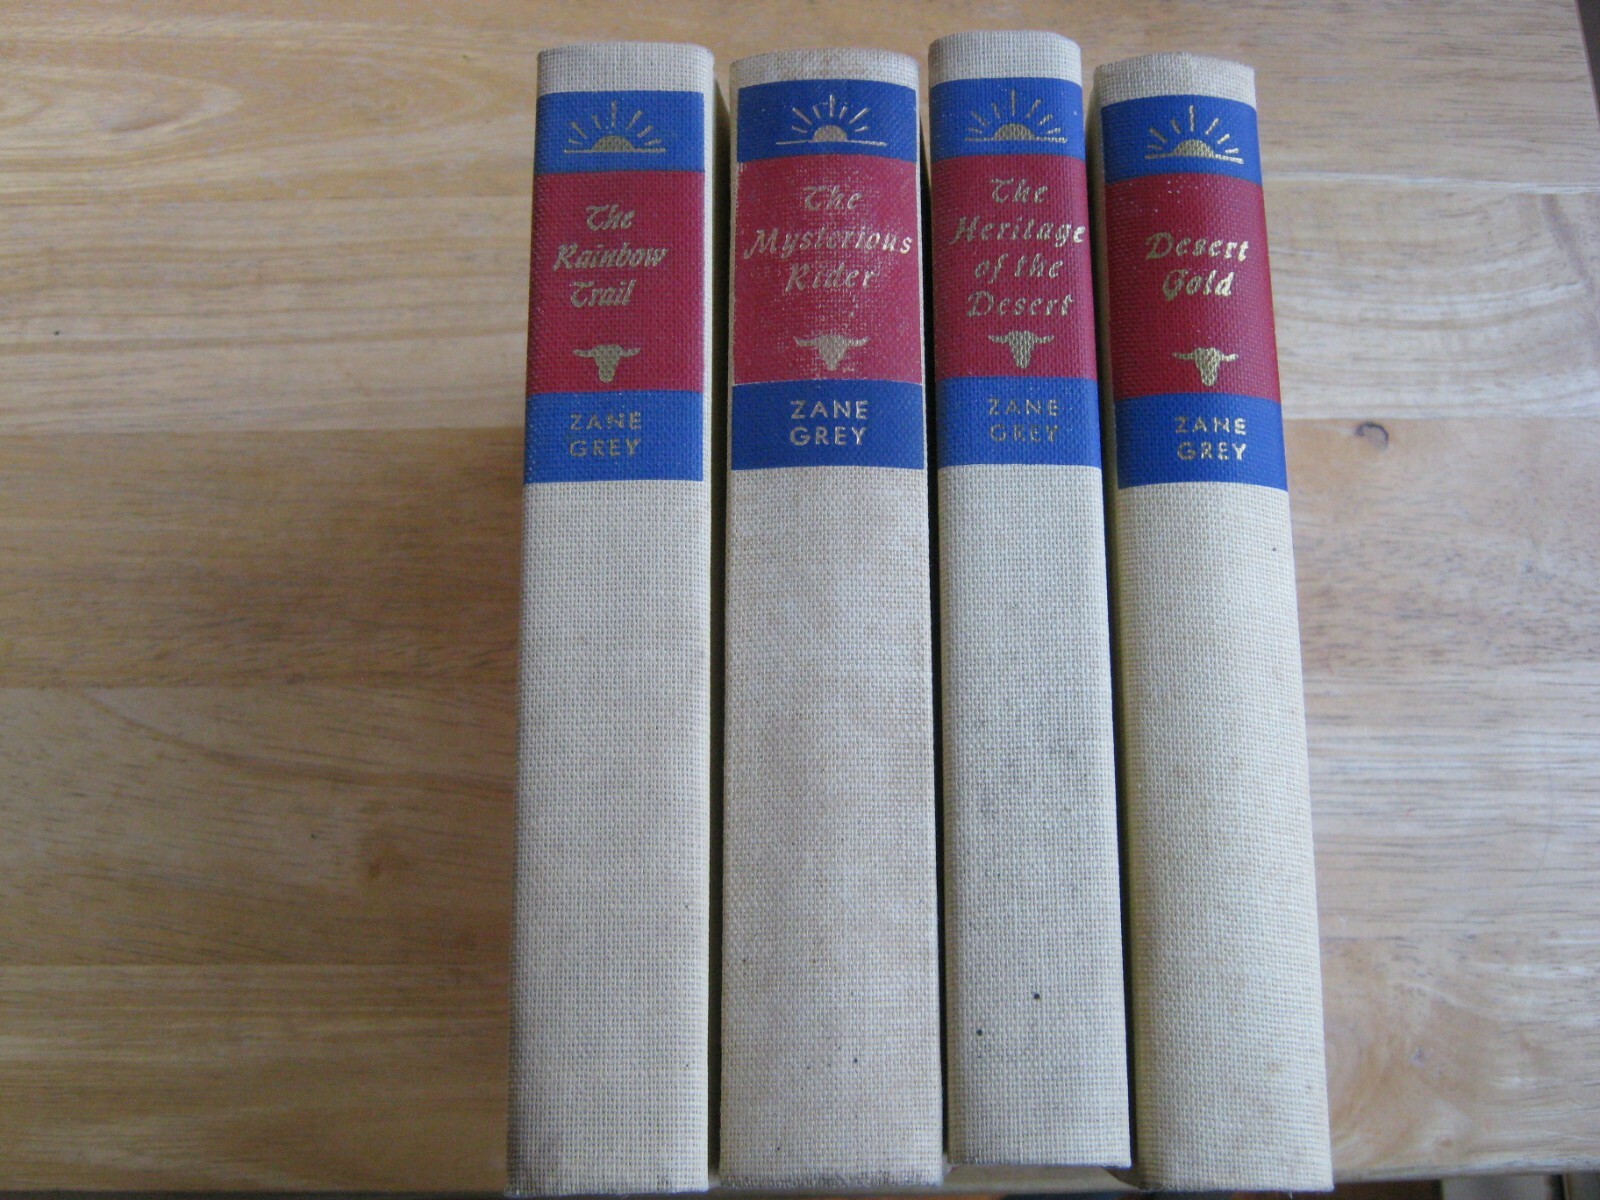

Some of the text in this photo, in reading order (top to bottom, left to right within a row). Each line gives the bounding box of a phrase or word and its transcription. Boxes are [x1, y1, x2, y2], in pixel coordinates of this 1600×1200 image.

[802, 185, 863, 211] The
[990, 177, 1049, 204] The
[585, 204, 636, 231] The
[744, 227, 913, 260] Mysterious
[949, 215, 1086, 248] Heritage
[553, 242, 669, 271] Rainbow
[1145, 231, 1249, 262] Desert
[785, 262, 877, 293] Rider
[974, 252, 1064, 284] of the
[569, 279, 637, 308] Trail
[1162, 269, 1236, 301] Gold
[966, 290, 1075, 318] Desert
[570, 411, 642, 431] ZANE
[789, 399, 869, 420] ZANE
[987, 398, 1060, 417] ZANE
[789, 425, 867, 446] GREY
[988, 423, 1060, 443] GREY
[1175, 416, 1247, 436] ZANE
[568, 437, 642, 458] GREY
[1177, 441, 1247, 461] GREY
